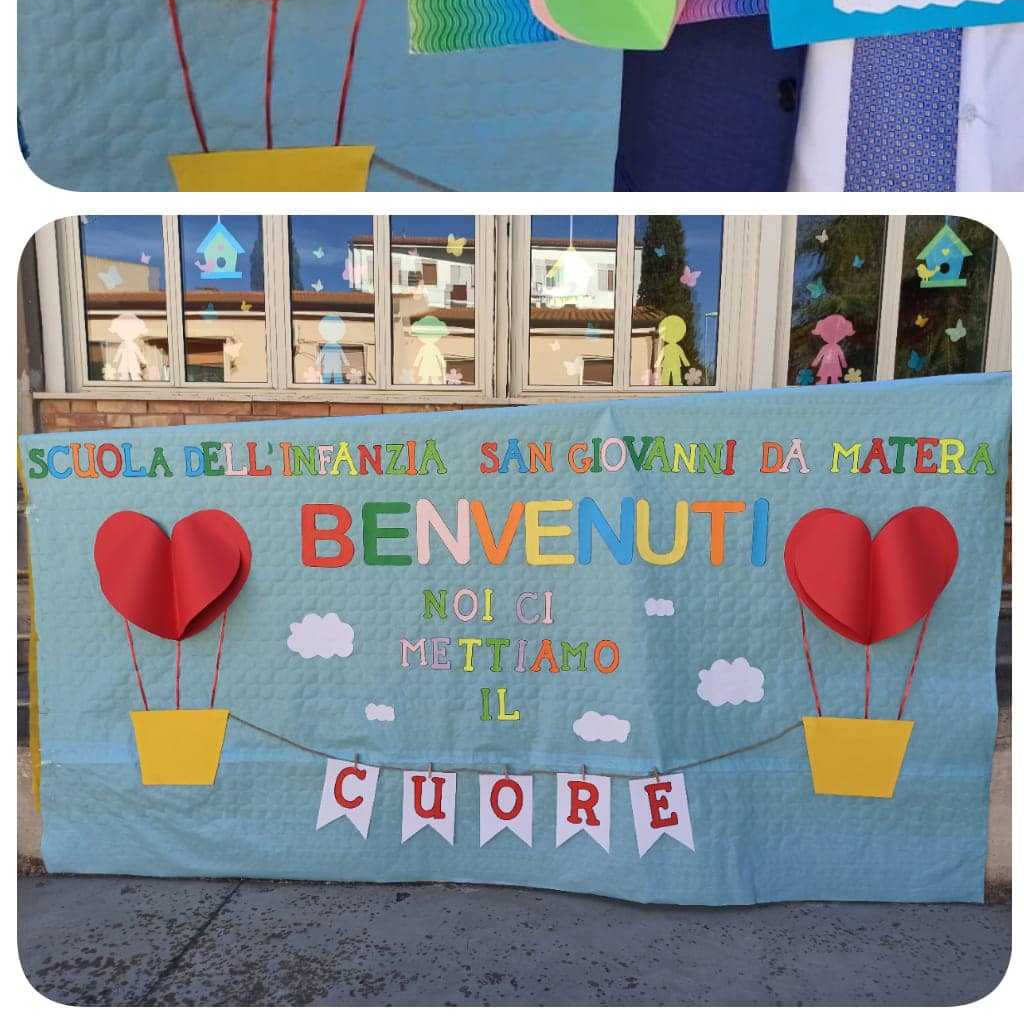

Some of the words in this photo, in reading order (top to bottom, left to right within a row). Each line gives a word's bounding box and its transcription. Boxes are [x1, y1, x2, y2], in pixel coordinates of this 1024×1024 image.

[29, 441, 173, 479] SCUOLA
[184, 439, 447, 477] DELL'INFANZIA
[480, 438, 553, 474] SAN
[567, 436, 737, 475] GIOVANNI
[760, 438, 811, 474] DA
[830, 437, 996, 475] MATERA
[300, 496, 770, 568] BENVENUTI
[422, 588, 495, 622] NOI
[516, 591, 554, 624] CI
[400, 638, 621, 674] METTIAMO
[479, 687, 521, 721] IL
[333, 767, 679, 829] CUORE
